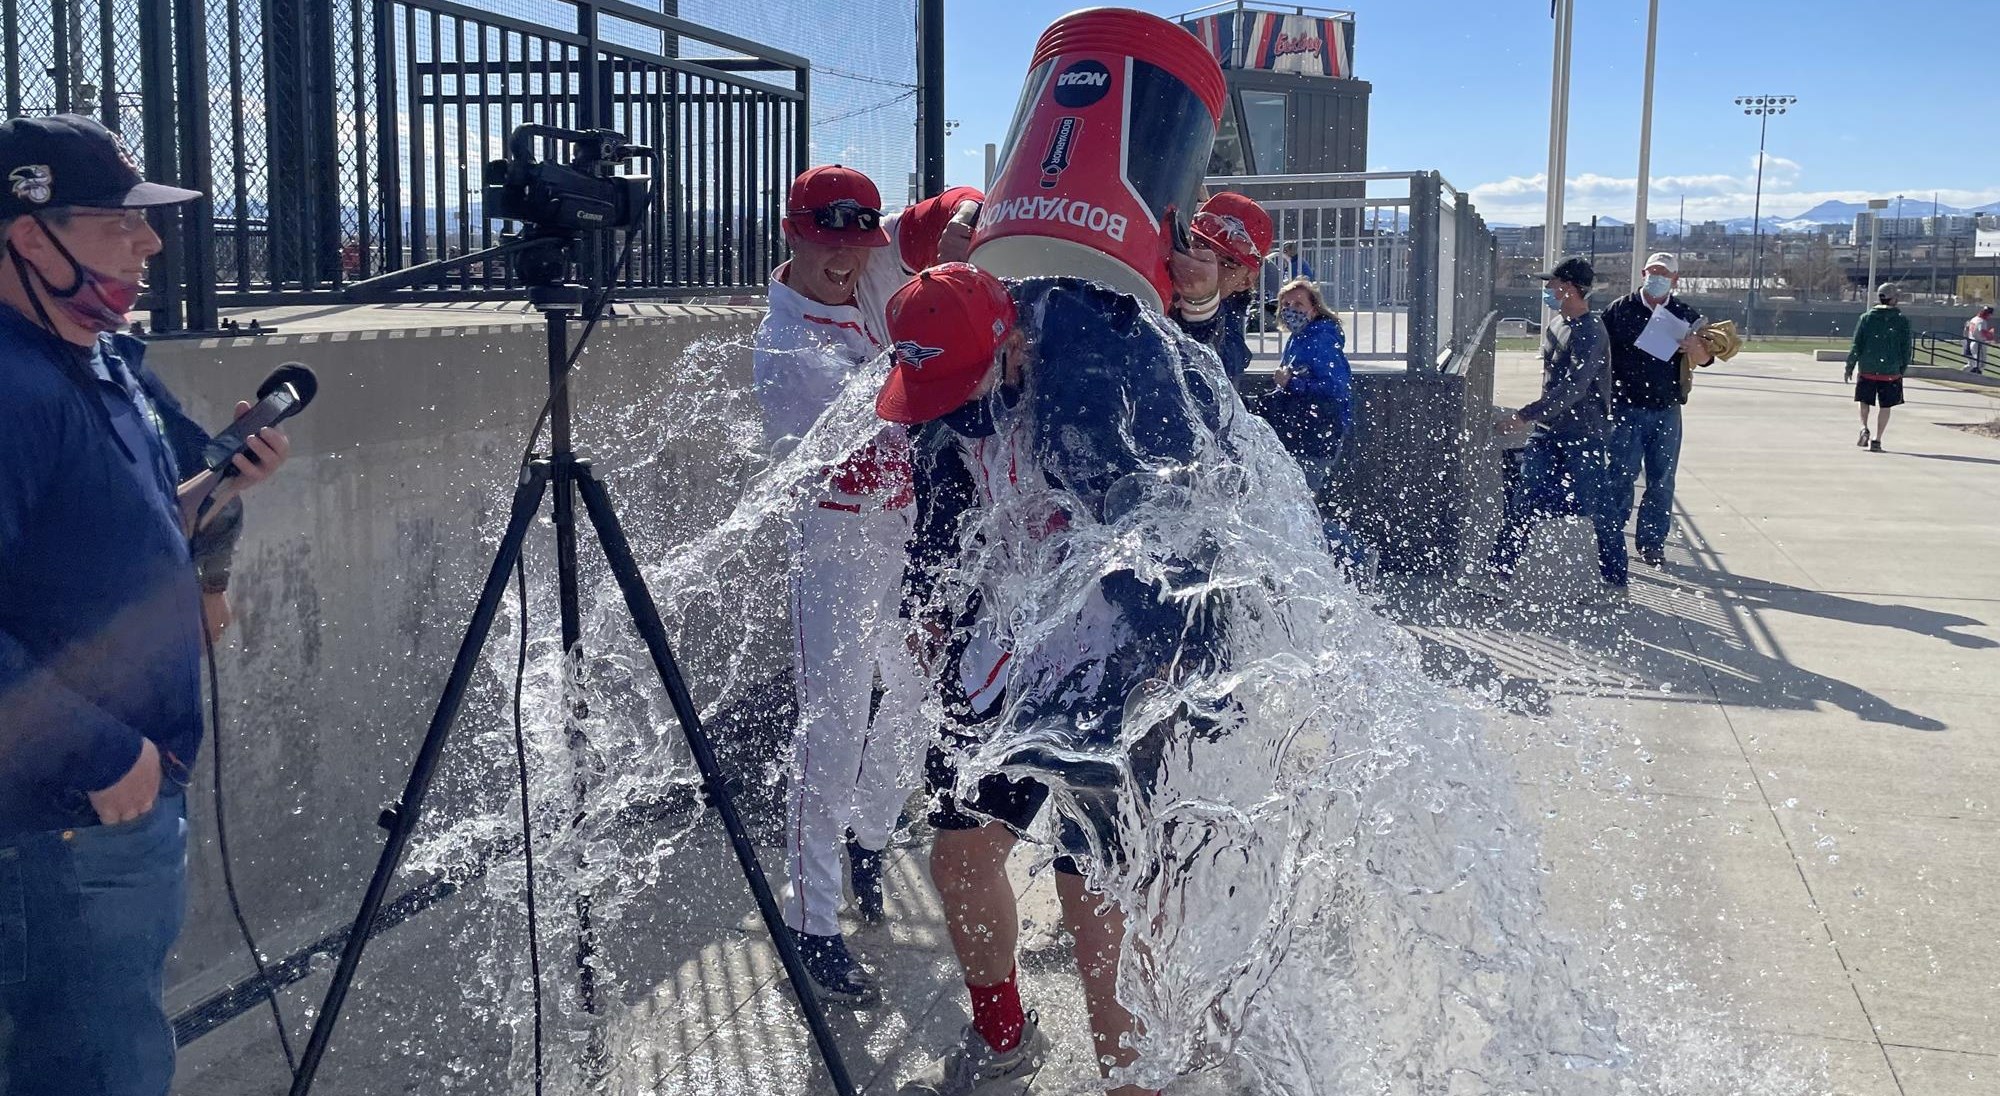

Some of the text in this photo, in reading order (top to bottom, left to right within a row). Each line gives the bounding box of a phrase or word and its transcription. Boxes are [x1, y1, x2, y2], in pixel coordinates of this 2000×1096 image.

[1057, 71, 1108, 86] NCAA
[1051, 119, 1073, 164] BODYARMOR
[576, 210, 603, 221] Canon
